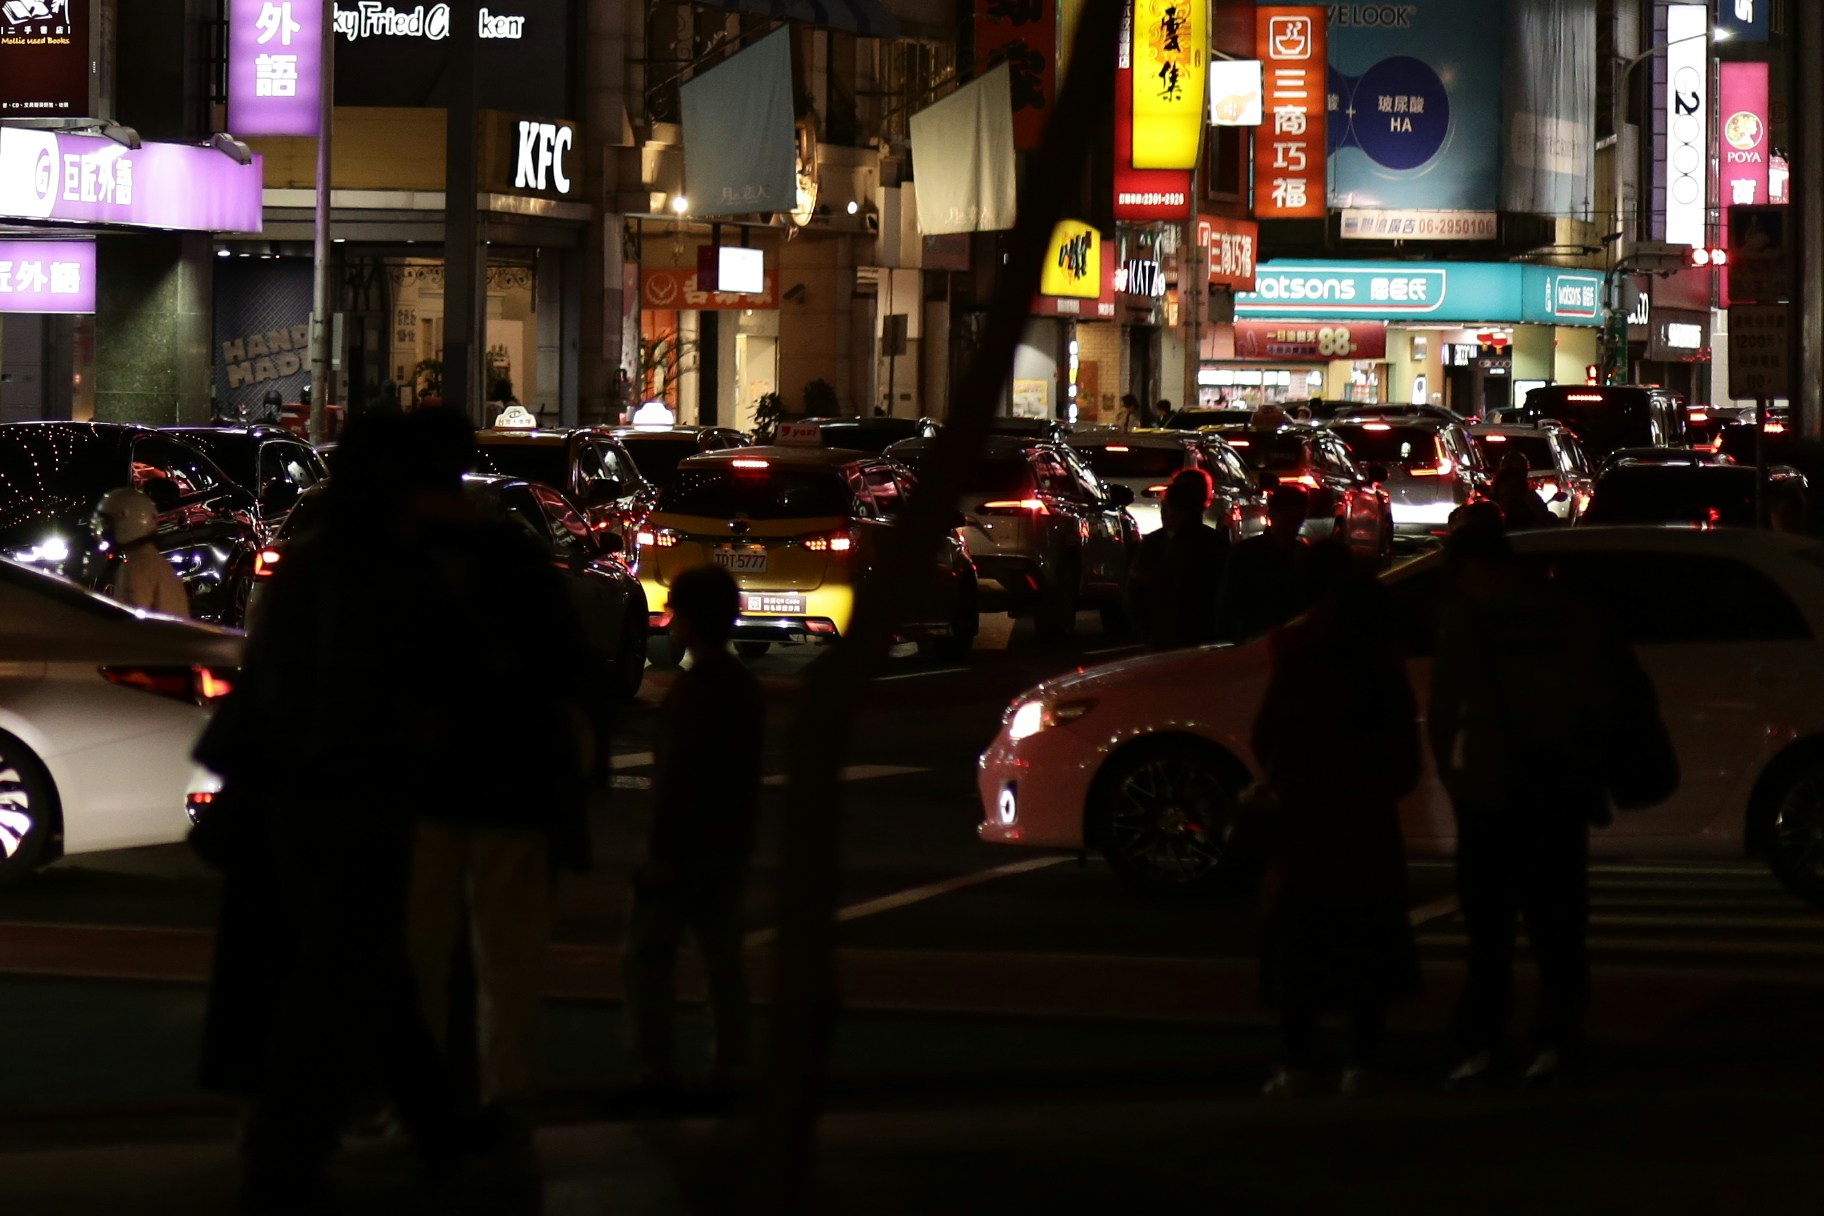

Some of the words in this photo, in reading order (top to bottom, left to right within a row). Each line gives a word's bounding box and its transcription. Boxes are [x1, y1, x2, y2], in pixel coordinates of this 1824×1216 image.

[358, 0, 424, 39] Fried
[1377, 94, 1425, 114] 玻尿酸
[1272, 67, 1309, 210] 三商巧福
[1389, 117, 1413, 133] HA
[514, 119, 573, 195] KFC
[1726, 152, 1762, 165] POYA
[62, 152, 134, 206] 巨匠外語
[1418, 217, 1494, 235] 06-2950106
[1210, 230, 1253, 279] 三商巧福
[1370, 276, 1428, 301] 屈臣氏
